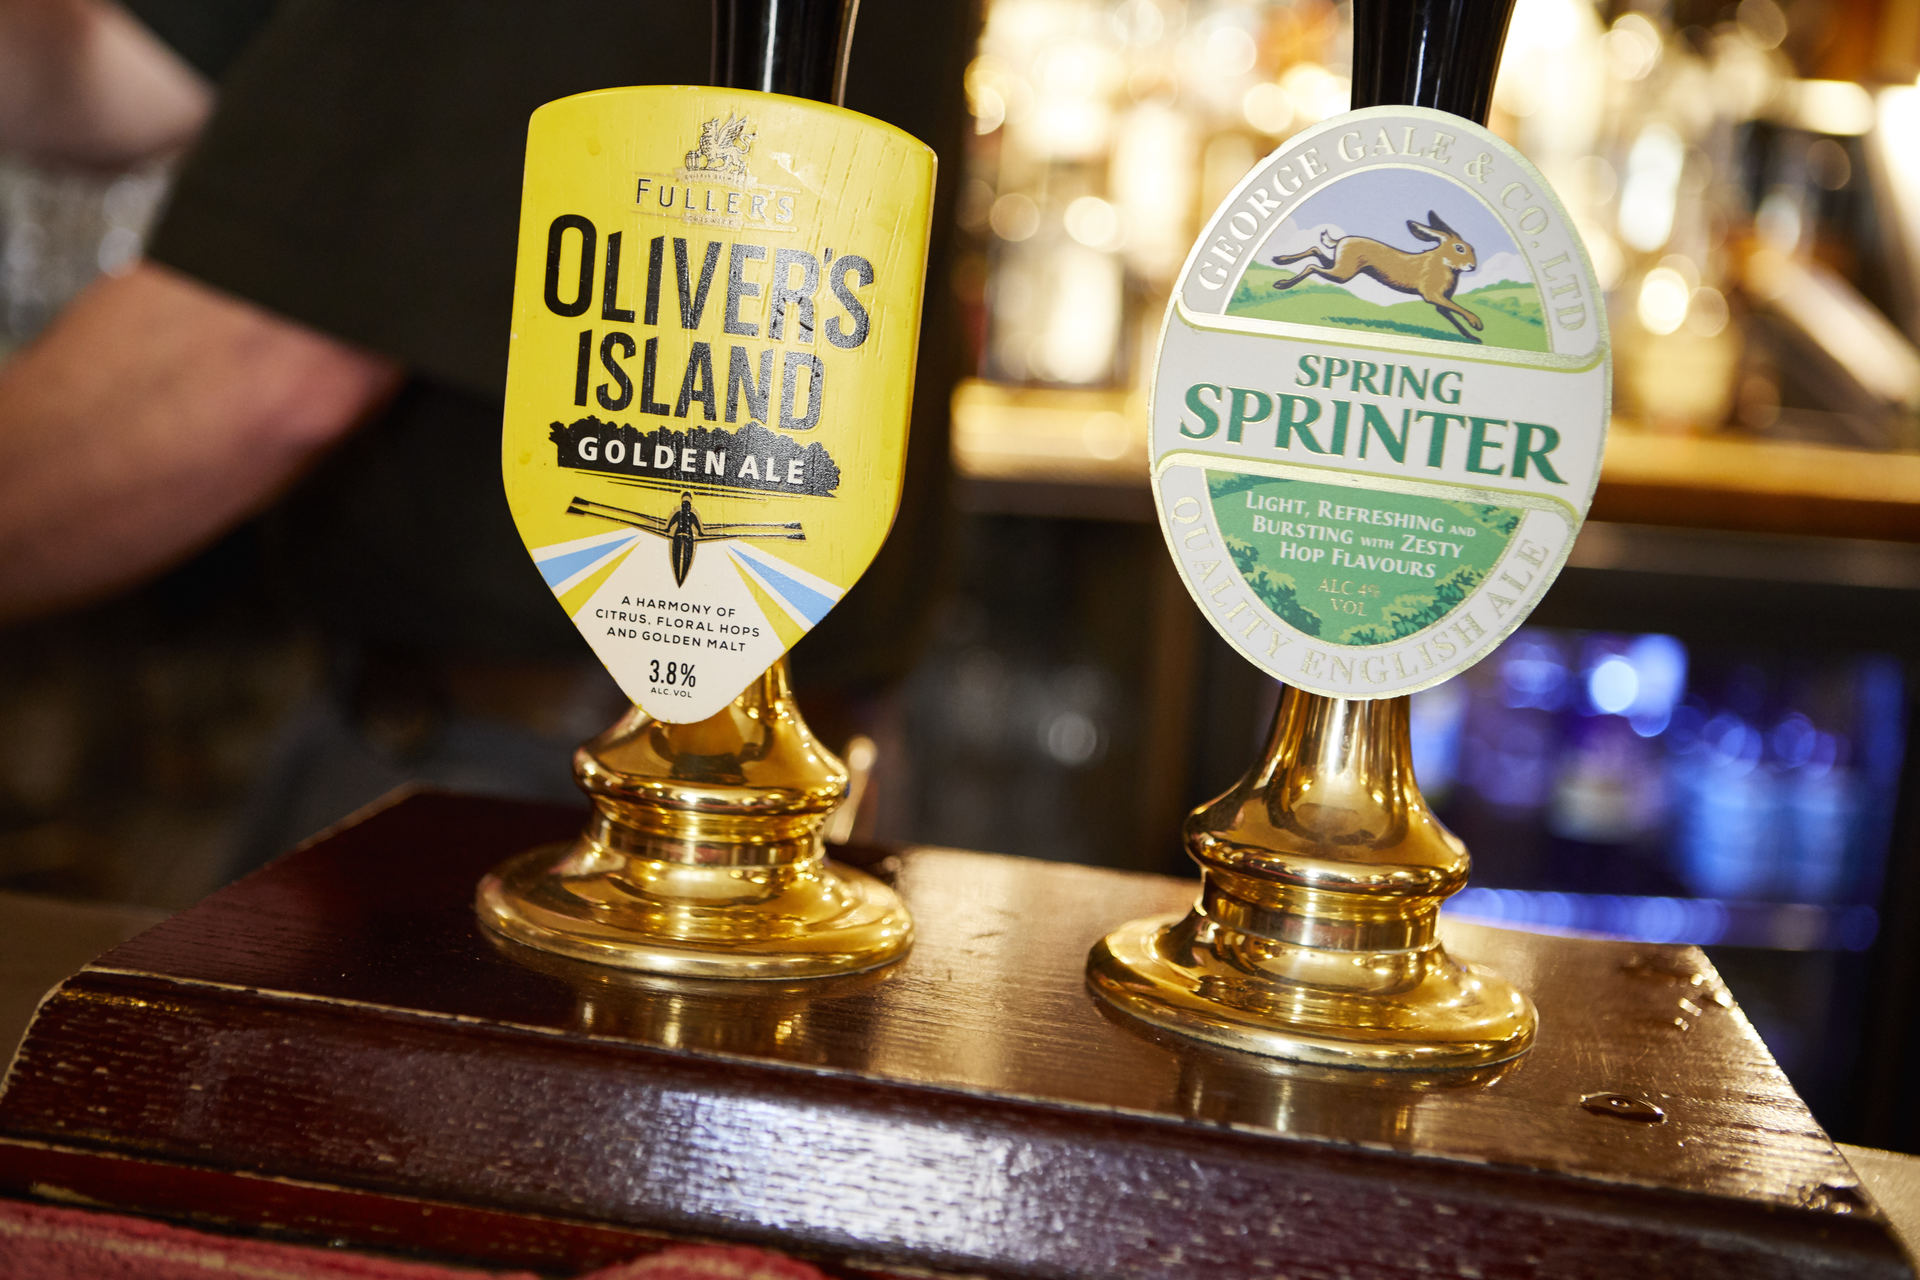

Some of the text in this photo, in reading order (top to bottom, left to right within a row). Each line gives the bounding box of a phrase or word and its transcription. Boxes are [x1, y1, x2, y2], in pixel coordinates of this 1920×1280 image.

[1199, 147, 1329, 292] GEORGE
[1337, 126, 1456, 165] GALE
[1464, 152, 1495, 184] &
[1540, 251, 1588, 333] LTD
[543, 213, 876, 351] OLIVER'S
[573, 328, 826, 431] ISLAND
[1296, 353, 1464, 405] SPRING
[1179, 383, 1568, 486] SPRINTER
[577, 436, 806, 485] GOLDEN ALE
[1246, 490, 1477, 538] LIGHT, REFRESHING AND
[1252, 514, 1465, 559] BURSTING WITH ZESTY
[1280, 541, 1437, 579] HOP FLAVOURS
[621, 595, 736, 618] A HARMONY OF
[1171, 496, 1551, 688] QUALITY ENGLISH ALE
[1318, 577, 1354, 595] ALC
[1330, 598, 1369, 617] VOL
[606, 626, 746, 653] AND GOLDEN MALT
[657, 616, 714, 632] FLORAL
[720, 624, 760, 638] HOPS
[649, 659, 697, 688] 3.8%
